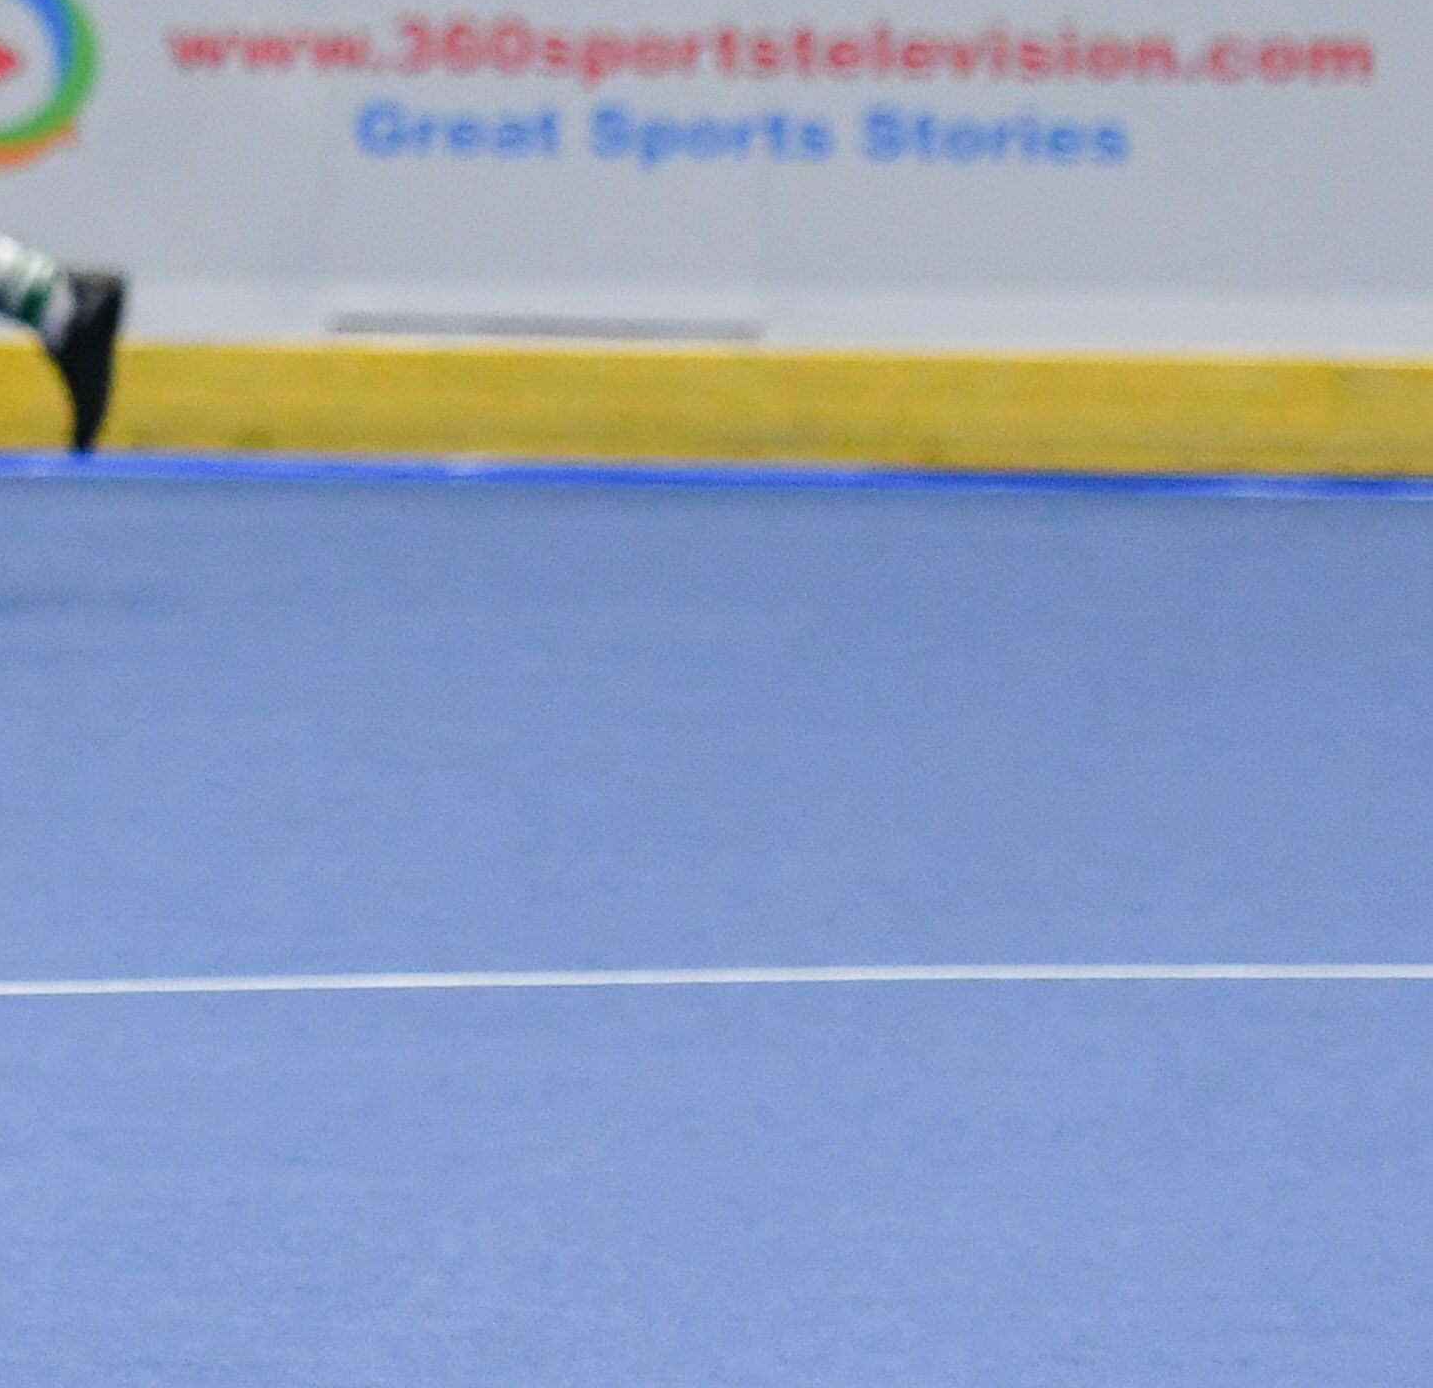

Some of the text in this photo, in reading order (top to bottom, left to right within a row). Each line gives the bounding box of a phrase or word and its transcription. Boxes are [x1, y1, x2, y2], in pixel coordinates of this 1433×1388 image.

[167, 14, 1376, 86] www.360sportstelevision.com
[355, 102, 1128, 170] Great Sports Stories
